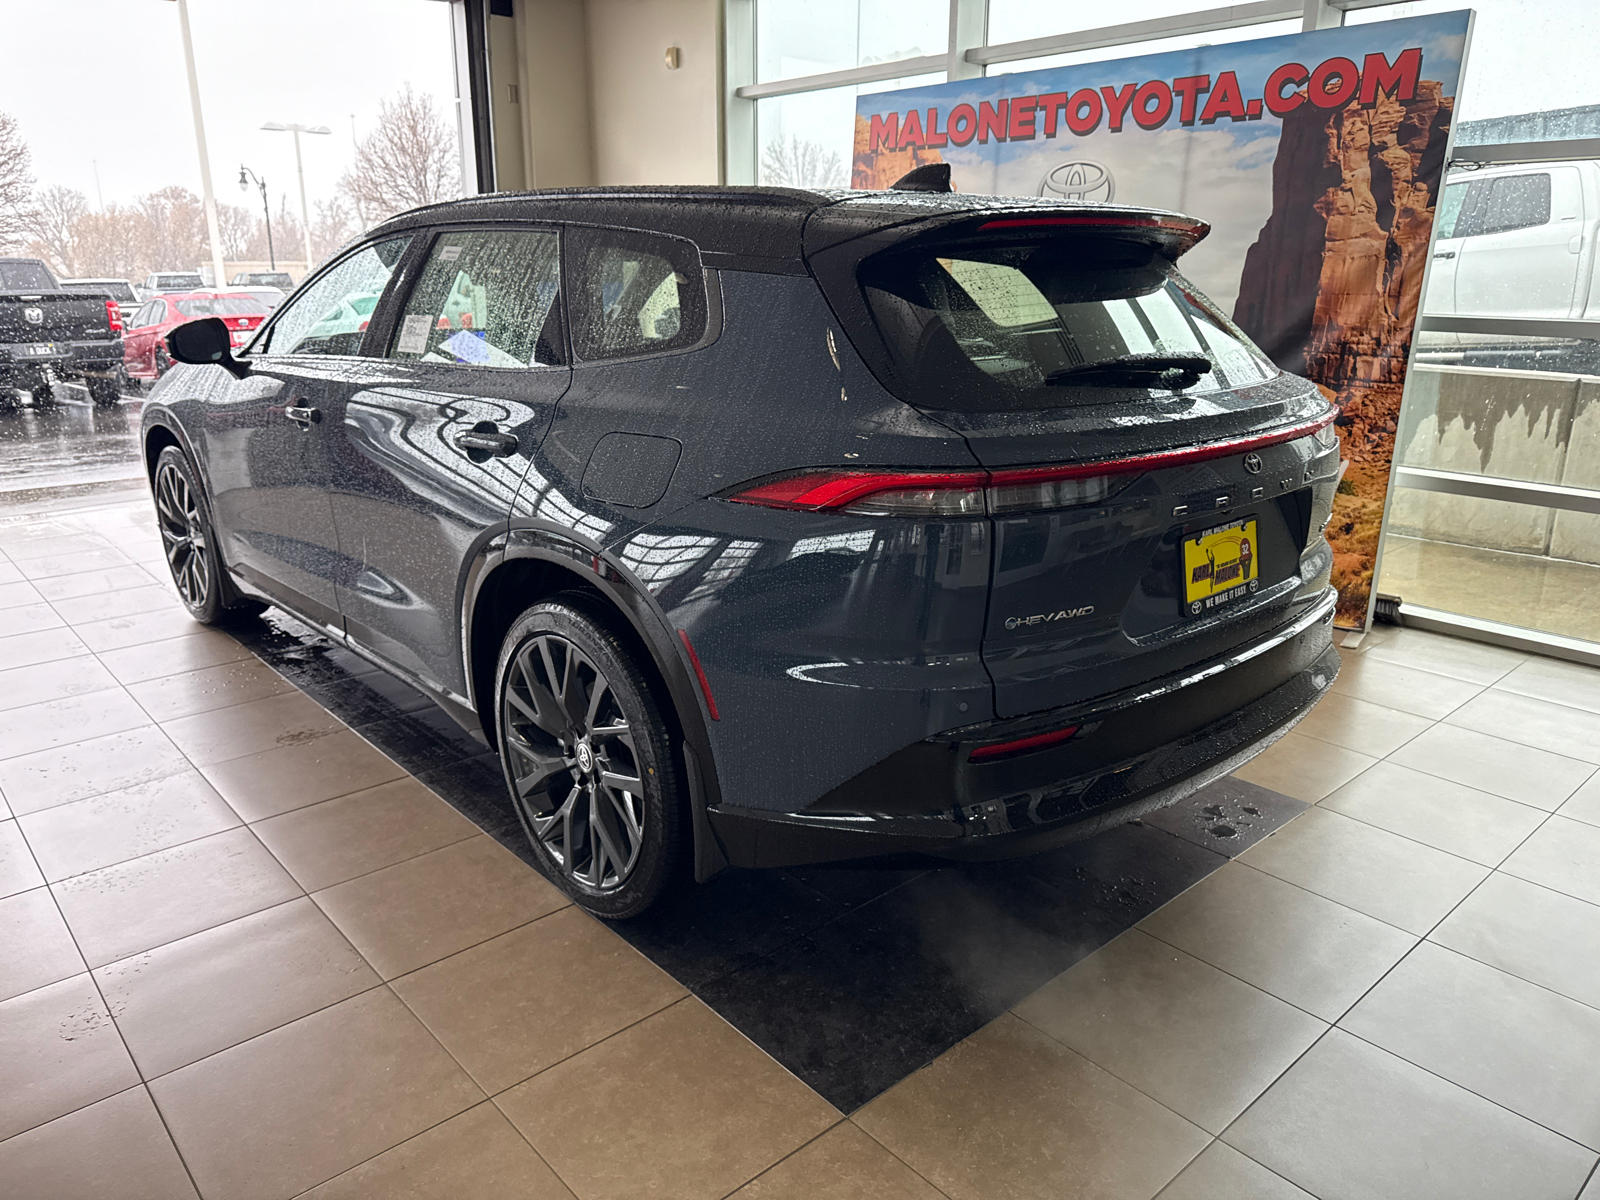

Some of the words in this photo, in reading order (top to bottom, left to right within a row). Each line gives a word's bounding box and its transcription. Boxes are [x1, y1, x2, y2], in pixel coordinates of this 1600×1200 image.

[869, 46, 1423, 152] MALONETOYOTA.COM
[1241, 543, 1250, 555] 32
[1191, 563, 1210, 584] KARL
[1214, 562, 1241, 586] MALONE
[1205, 598, 1214, 609] WE
[1214, 592, 1228, 603] MAKE
[1228, 589, 1235, 599] IT
[1234, 585, 1247, 597] EASY
[1054, 605, 1095, 621] AWD
